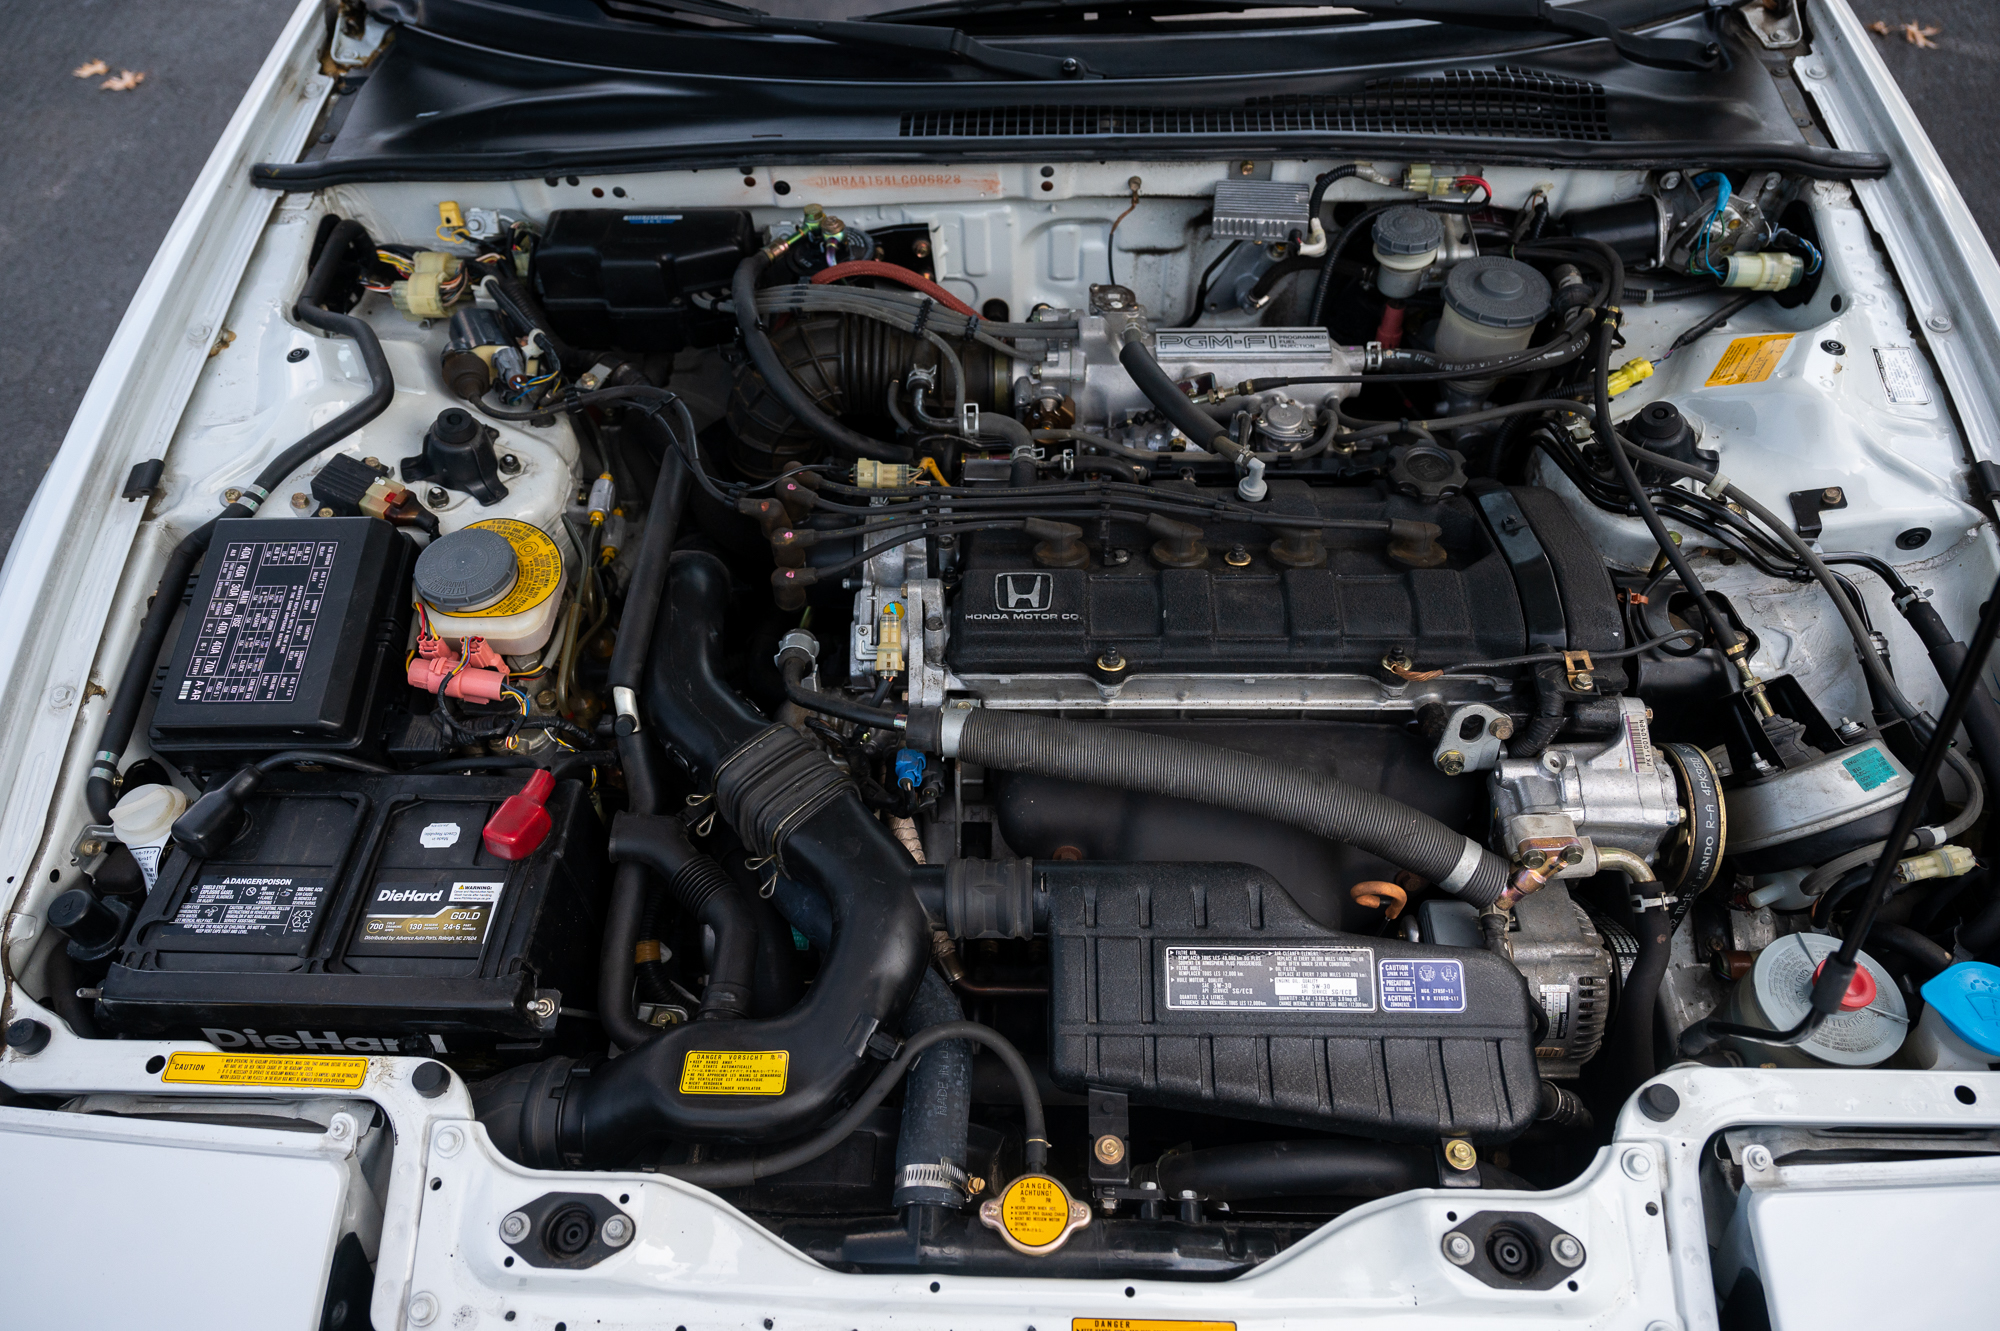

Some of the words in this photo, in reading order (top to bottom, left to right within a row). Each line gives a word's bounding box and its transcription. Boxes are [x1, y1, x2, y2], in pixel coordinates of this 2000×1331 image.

[1160, 335, 1276, 348] PGM-FI
[240, 547, 252, 559] 40A
[234, 565, 246, 577] 40A
[229, 584, 240, 596] 30A
[239, 591, 250, 604] MAIN
[222, 603, 234, 615] 40A
[216, 621, 228, 634] 40A
[232, 615, 242, 627] FUSE
[210, 641, 222, 654] 40A
[192, 658, 202, 675] BATTERY
[203, 660, 216, 673] 70A
[1689, 757, 1711, 796] 4PK980
[1706, 804, 1714, 829] R-A
[377, 890, 443, 901] DieHard
[938, 1065, 950, 1076] IN
[936, 1081, 948, 1116] MADE
